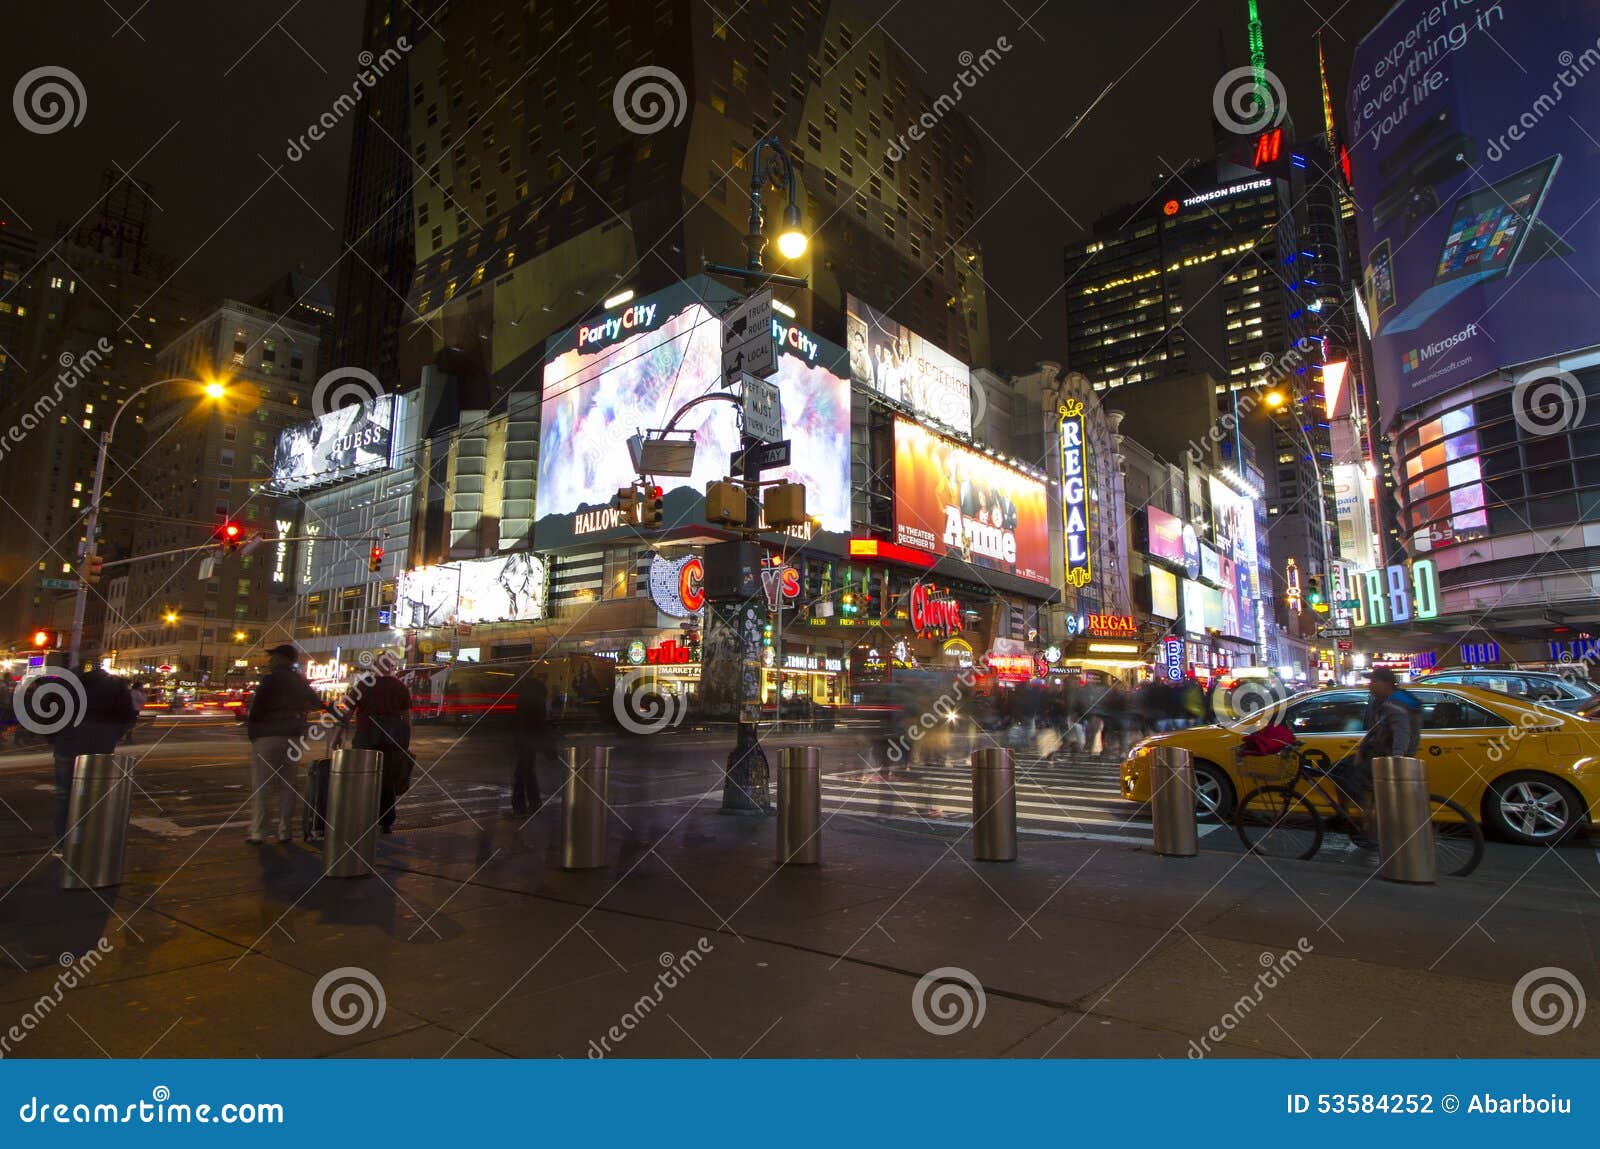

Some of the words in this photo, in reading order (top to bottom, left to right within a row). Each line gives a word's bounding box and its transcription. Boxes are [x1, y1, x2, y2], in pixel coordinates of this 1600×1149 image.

[1375, 0, 1474, 78] experien
[1363, 23, 1467, 119] everything
[1475, 5, 1504, 30] in
[1371, 98, 1410, 150] your
[1412, 70, 1449, 105] life.
[1184, 188, 1228, 207] THOMSON
[1229, 179, 1272, 195] REUTERS
[748, 301, 770, 319] TRUCK
[748, 316, 770, 336] ROUTE
[747, 344, 769, 362] LOCAL
[1420, 322, 1478, 361] Microsoft
[1411, 356, 1473, 388] www.microsoft.com
[752, 401, 772, 418] MUST
[331, 426, 382, 453] GUESS
[1062, 421, 1087, 562] REGAL
[898, 524, 905, 533] IN
[906, 526, 936, 542] THEATERS
[898, 533, 929, 549] DECEMBER
[273, 519, 292, 583] WESTIN
[1088, 614, 1137, 631] REGAL
[785, 655, 817, 669] STROMOLI
[1168, 641, 1182, 681] BBQ
